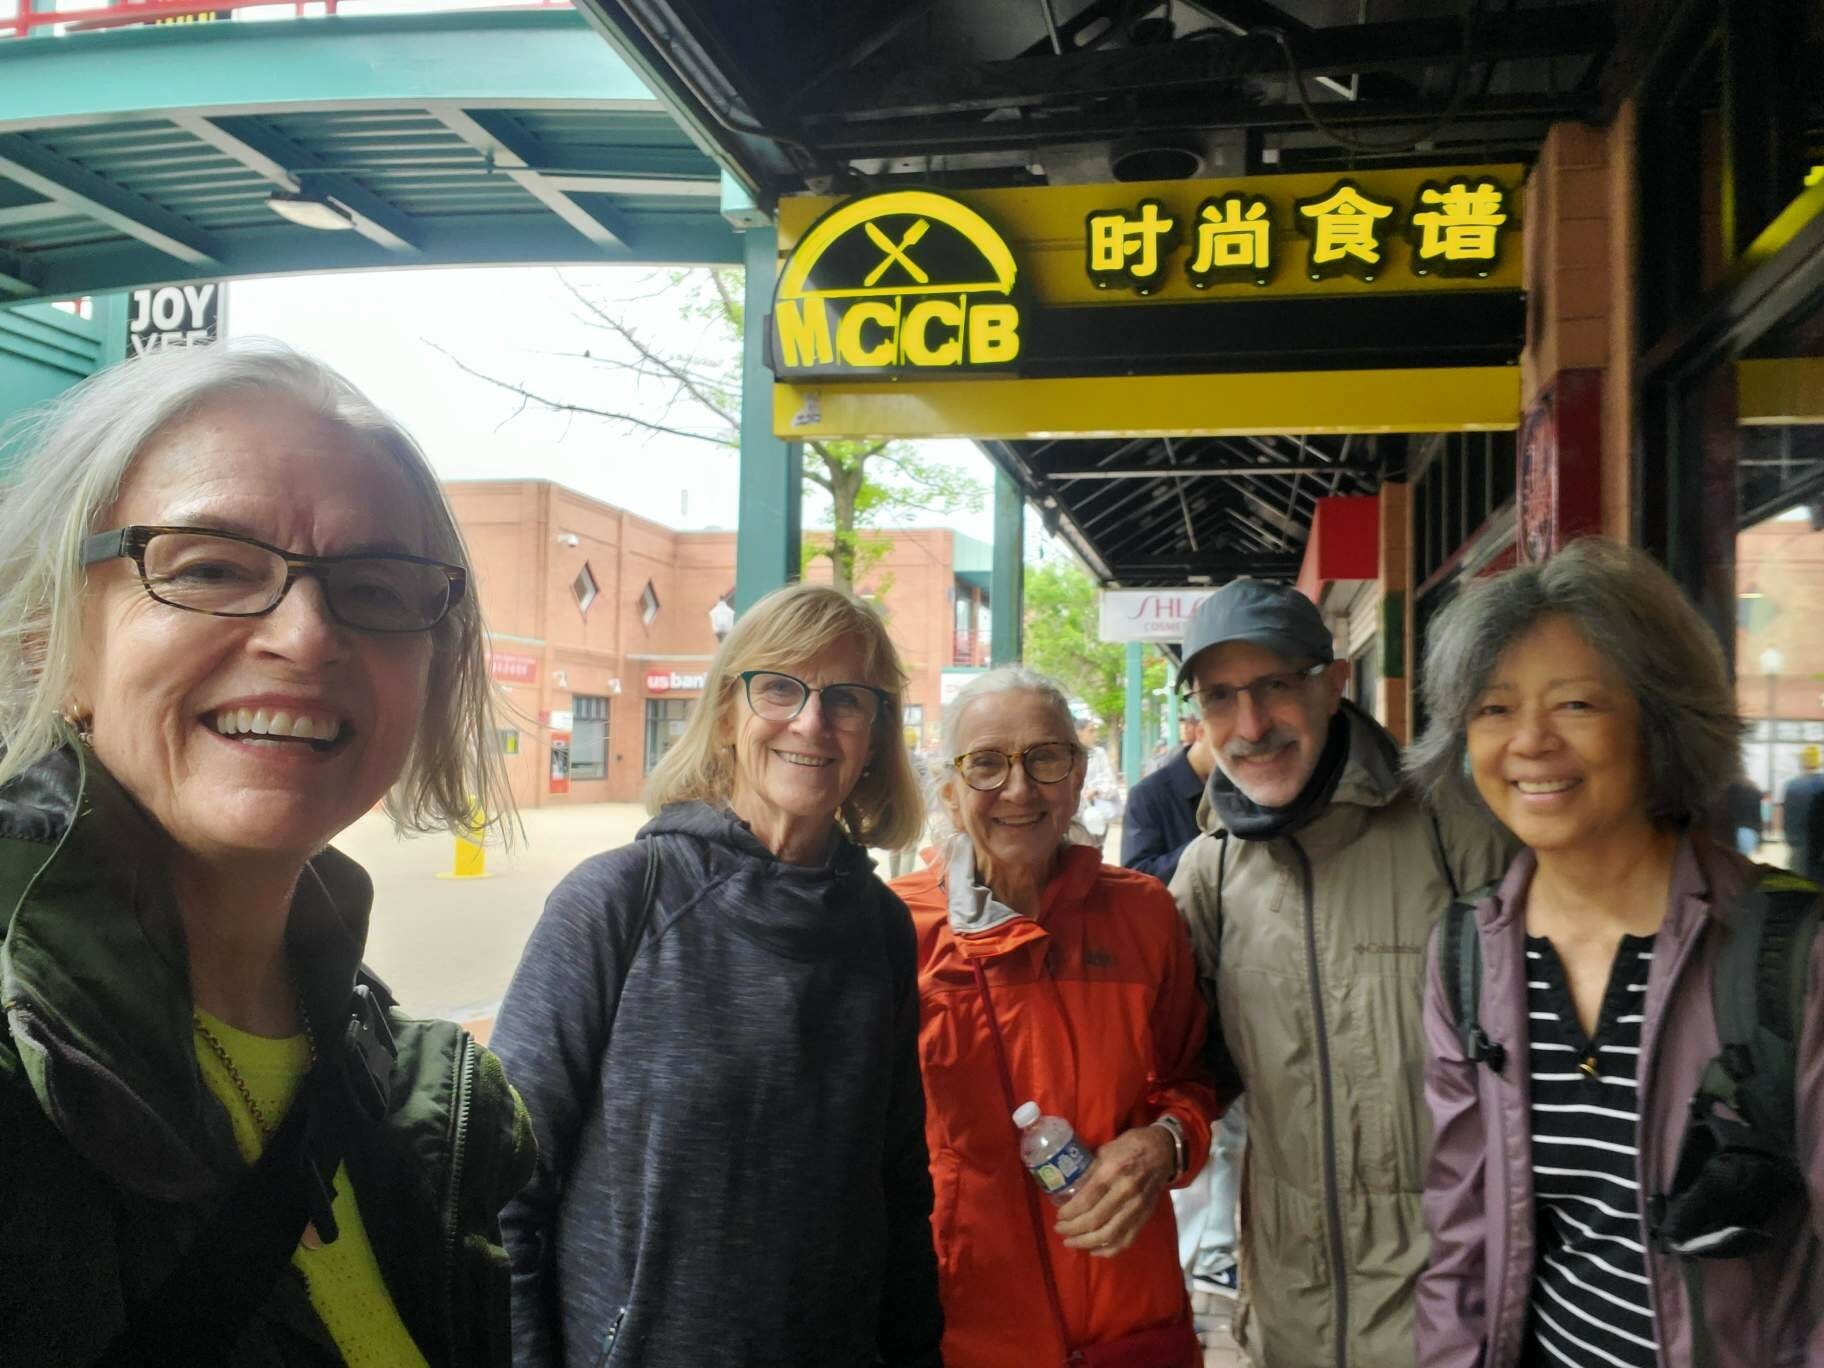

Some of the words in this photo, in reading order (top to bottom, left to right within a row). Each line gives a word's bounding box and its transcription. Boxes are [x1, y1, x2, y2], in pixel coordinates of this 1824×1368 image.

[1091, 184, 1506, 277] 时尚食谱
[131, 284, 215, 331] JOY
[775, 294, 1019, 367] MCCB
